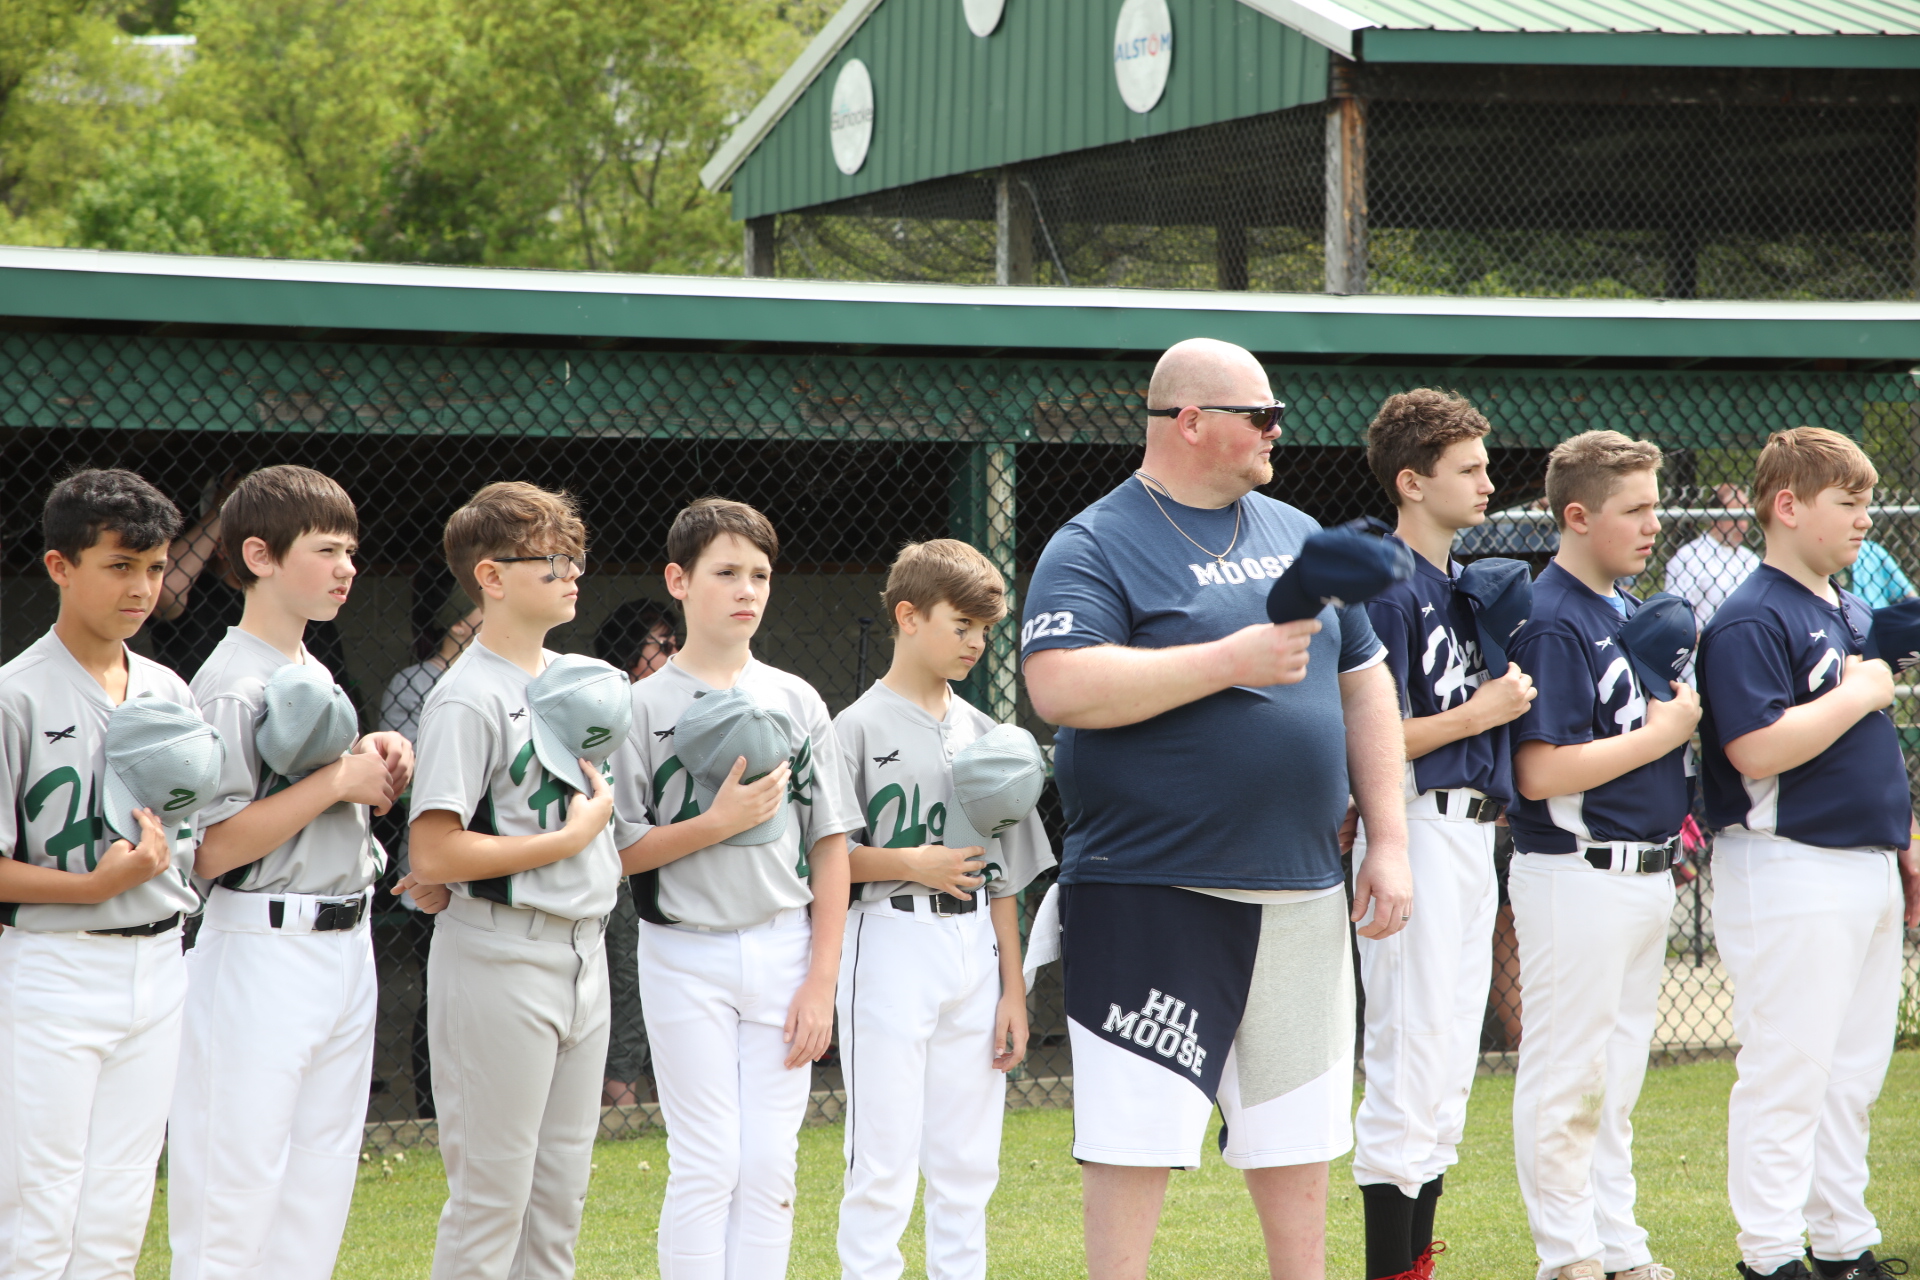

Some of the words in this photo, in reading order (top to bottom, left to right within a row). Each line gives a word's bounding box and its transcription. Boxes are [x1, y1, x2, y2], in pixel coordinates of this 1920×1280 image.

[1113, 32, 1171, 62] ALSTOM
[1021, 611, 1073, 651] 023
[1101, 1002, 1207, 1078] MOOSE
